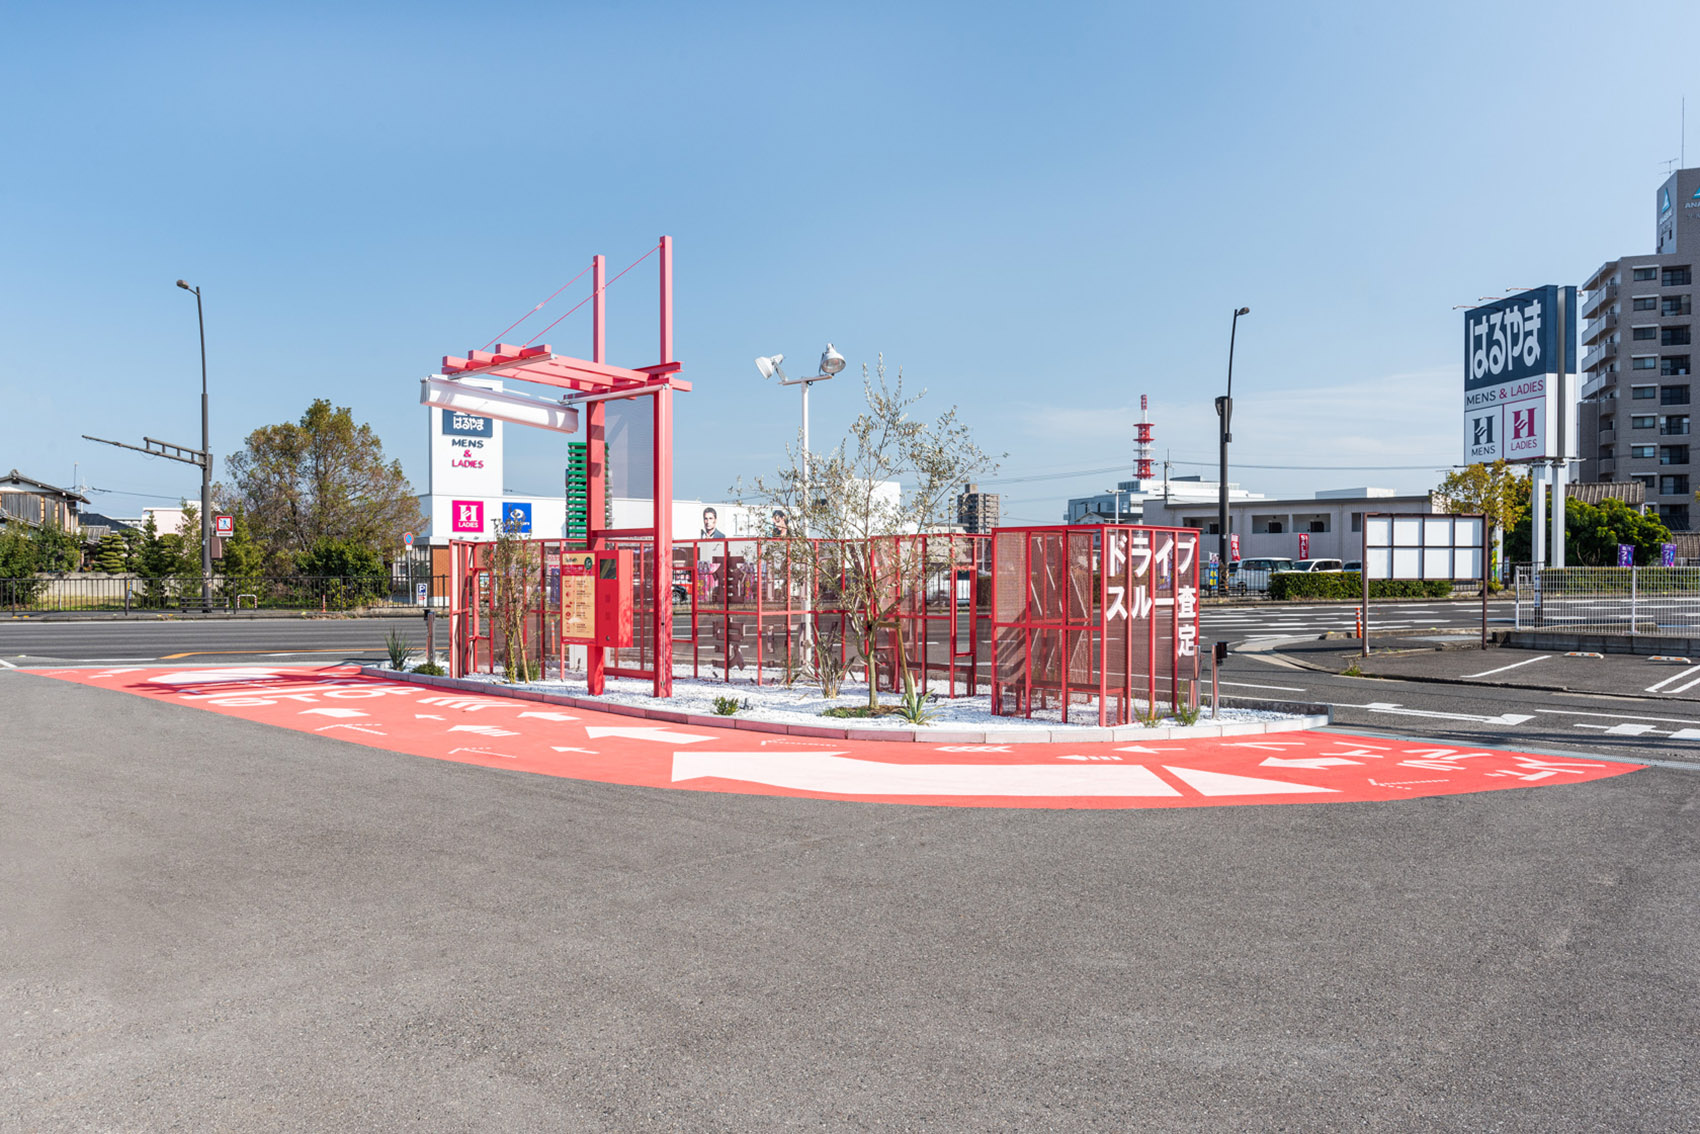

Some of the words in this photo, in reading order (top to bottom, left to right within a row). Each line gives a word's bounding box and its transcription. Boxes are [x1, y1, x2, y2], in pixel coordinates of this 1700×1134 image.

[1469, 299, 1541, 380] はるやま
[1466, 390, 1496, 406] MENS
[1498, 387, 1507, 400] &
[1510, 379, 1544, 397] LADIES
[453, 416, 485, 431] はるやま
[451, 438, 484, 449] MENS
[1510, 439, 1538, 451] LADIES
[463, 449, 472, 458] &
[1471, 445, 1496, 457] MENS
[451, 459, 484, 469] LADIES
[208, 686, 426, 707] STOP
